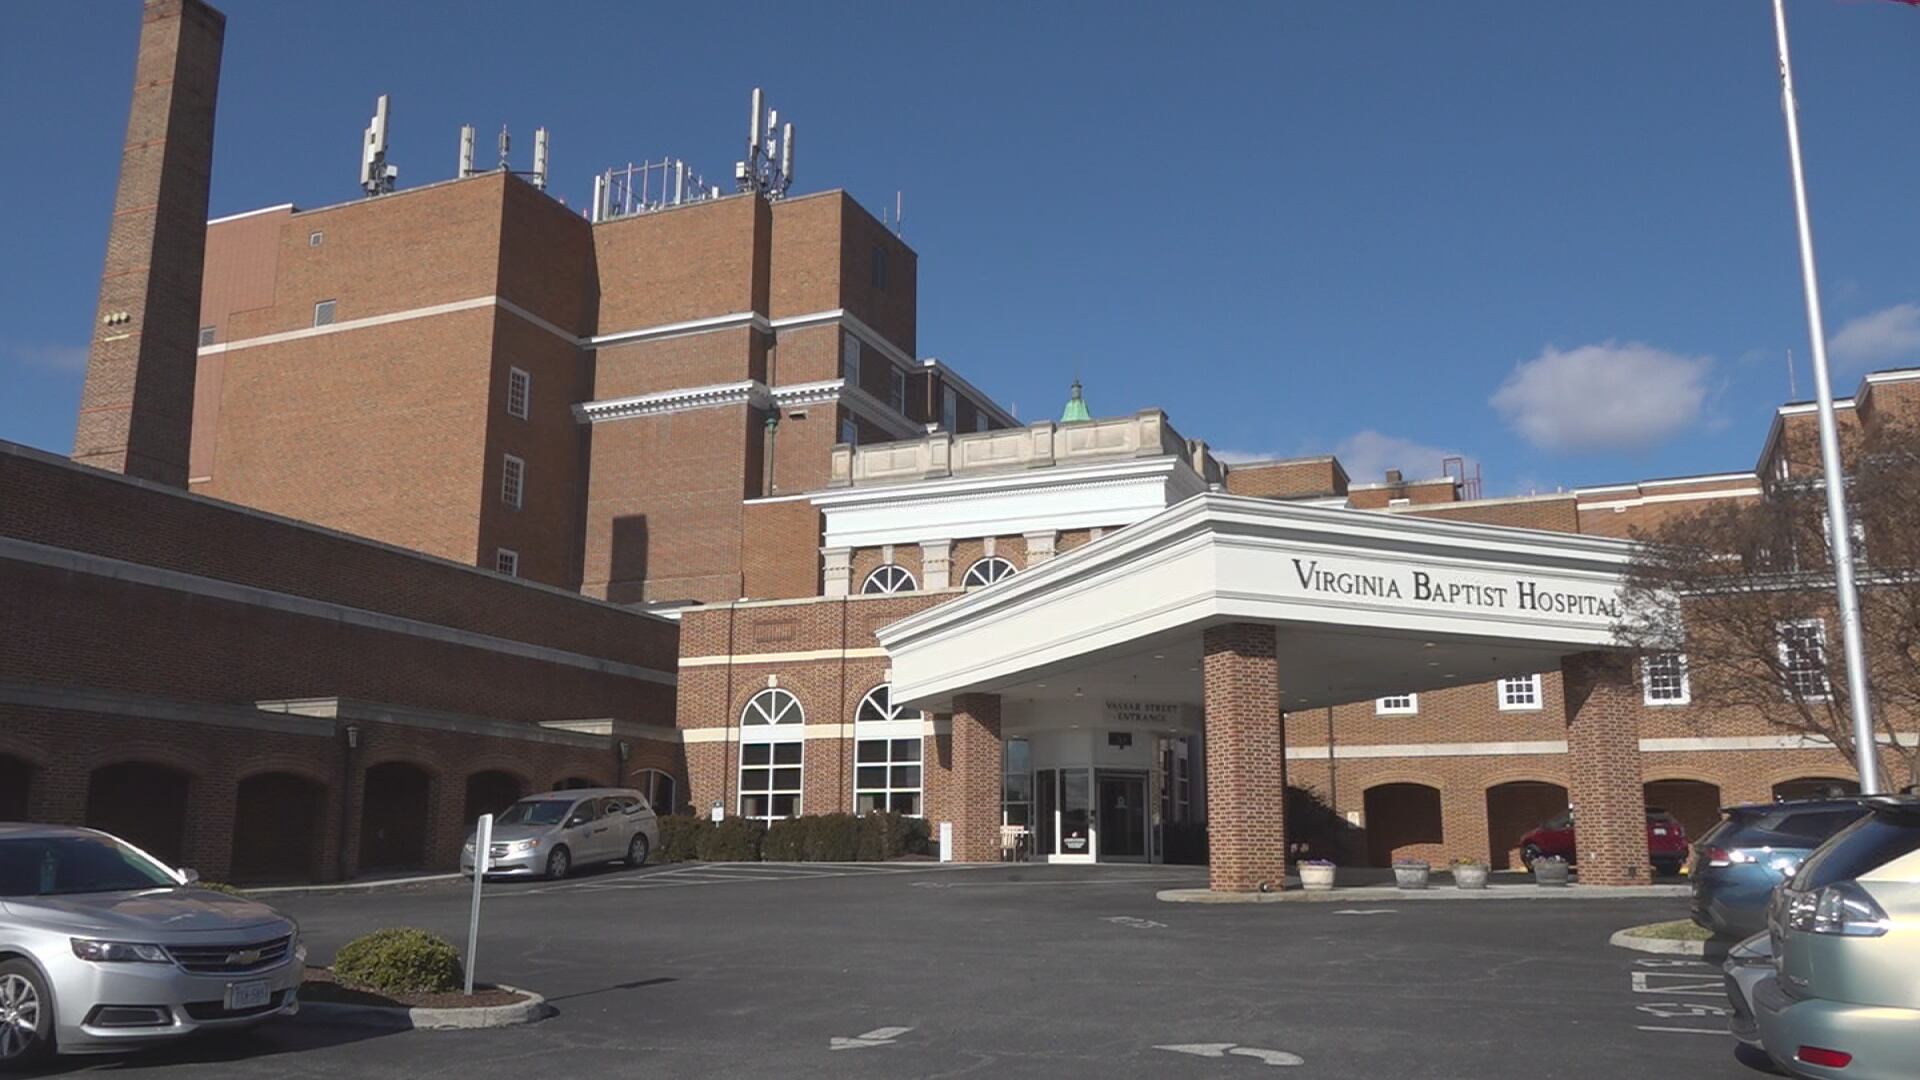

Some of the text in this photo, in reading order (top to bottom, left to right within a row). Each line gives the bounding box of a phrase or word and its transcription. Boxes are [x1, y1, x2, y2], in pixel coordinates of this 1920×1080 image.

[1291, 558, 1623, 618] VIRGINIA BAPTIST HOSPITAL
